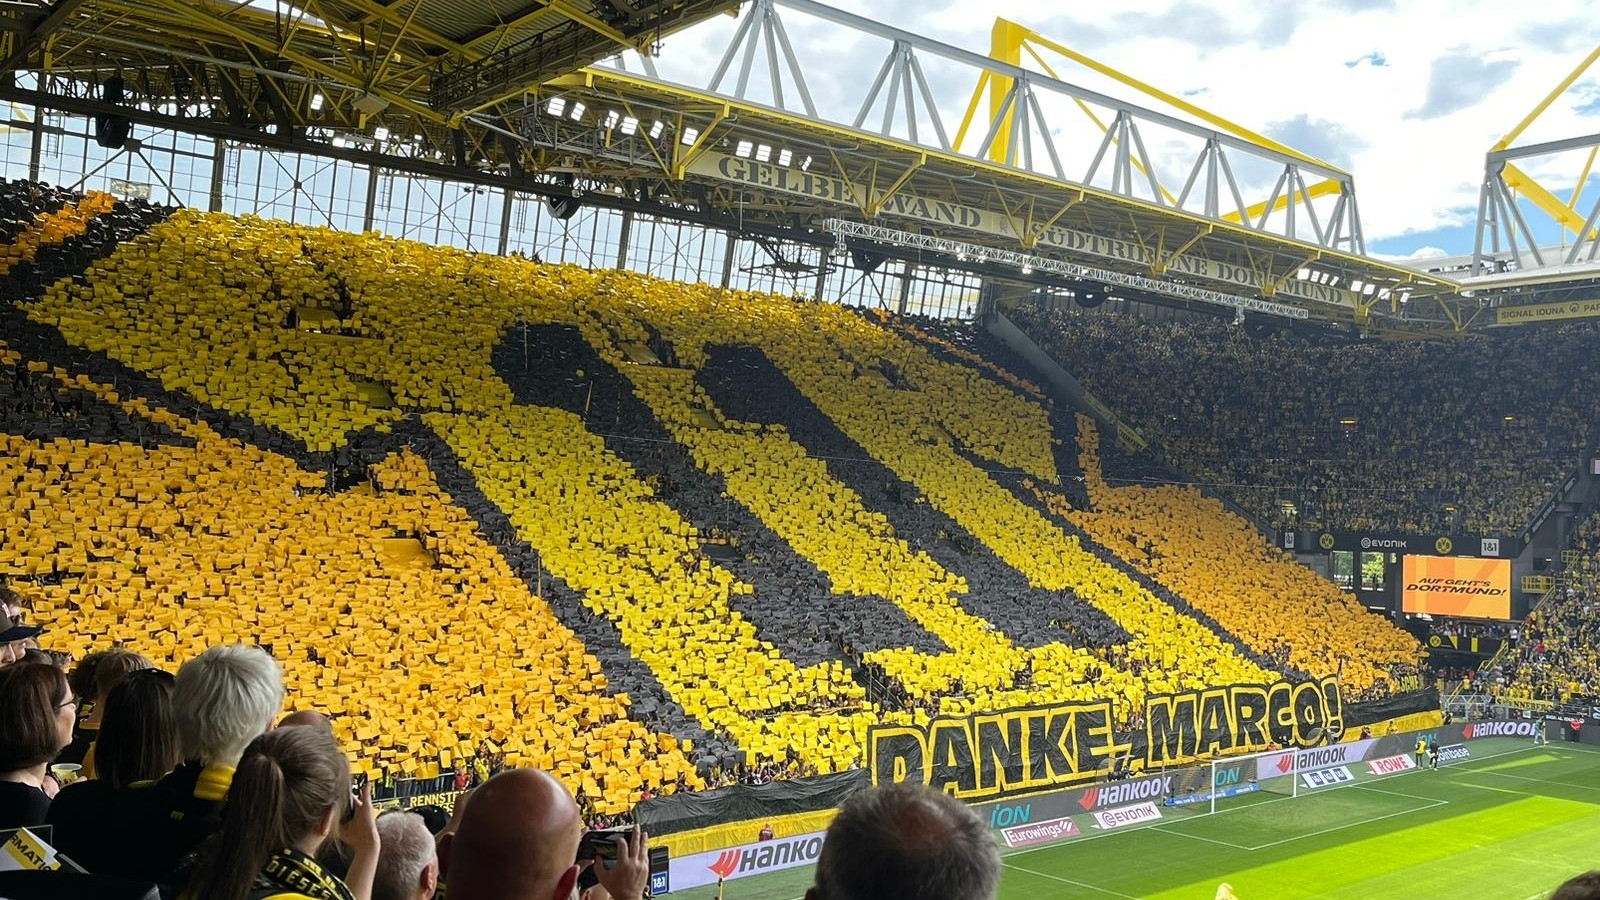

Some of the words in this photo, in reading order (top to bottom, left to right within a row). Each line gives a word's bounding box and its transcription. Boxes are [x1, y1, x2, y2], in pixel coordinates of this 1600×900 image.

[718, 156, 855, 203] GELBE
[881, 196, 982, 227] WAND
[1501, 310, 1534, 319] SIGNAL
[1536, 306, 1565, 316] IDUNA
[1483, 541, 1497, 552] 1&1
[1406, 584, 1507, 596] DORTMUND!
[1145, 676, 1345, 769] MARCO!
[1374, 755, 1409, 772] ROWE
[1006, 824, 1062, 844] Eurowings
[653, 876, 666, 889] 1&1
